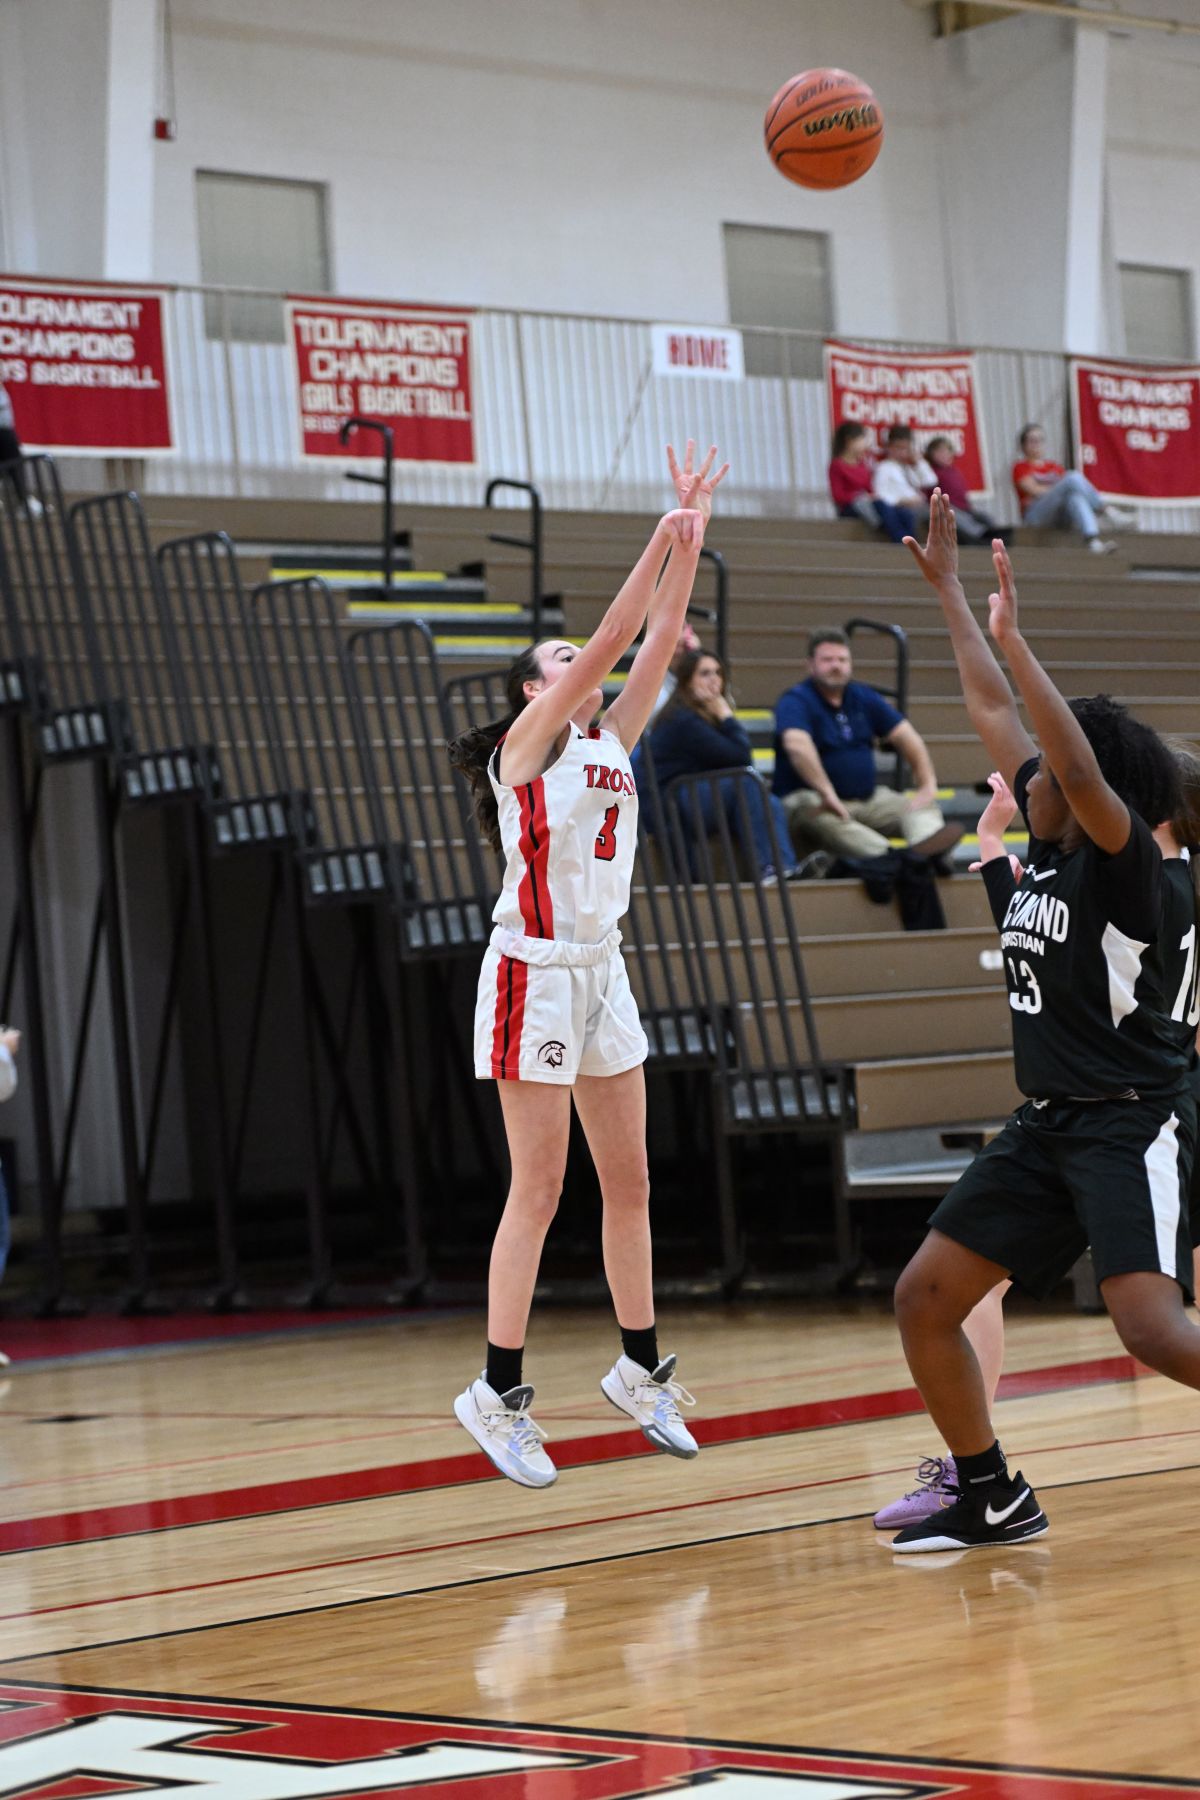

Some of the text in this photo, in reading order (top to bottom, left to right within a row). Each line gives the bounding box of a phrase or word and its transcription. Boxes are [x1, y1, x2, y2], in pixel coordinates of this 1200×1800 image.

[0, 326, 136, 362] CHAMPIONS
[296, 315, 468, 356] TOURNAMENT
[667, 334, 728, 368] HOME
[30, 360, 161, 389] BASKETBALL
[309, 349, 459, 388] CHAMPIONS
[834, 358, 969, 397] TOURNAMENT
[301, 381, 472, 420] GIRLS BASKETBALL
[1089, 373, 1193, 405] TOURNAMENT
[842, 391, 968, 426] CHAMPIONS
[1098, 400, 1191, 431] CHAMPIONS
[594, 802, 620, 862] 3
